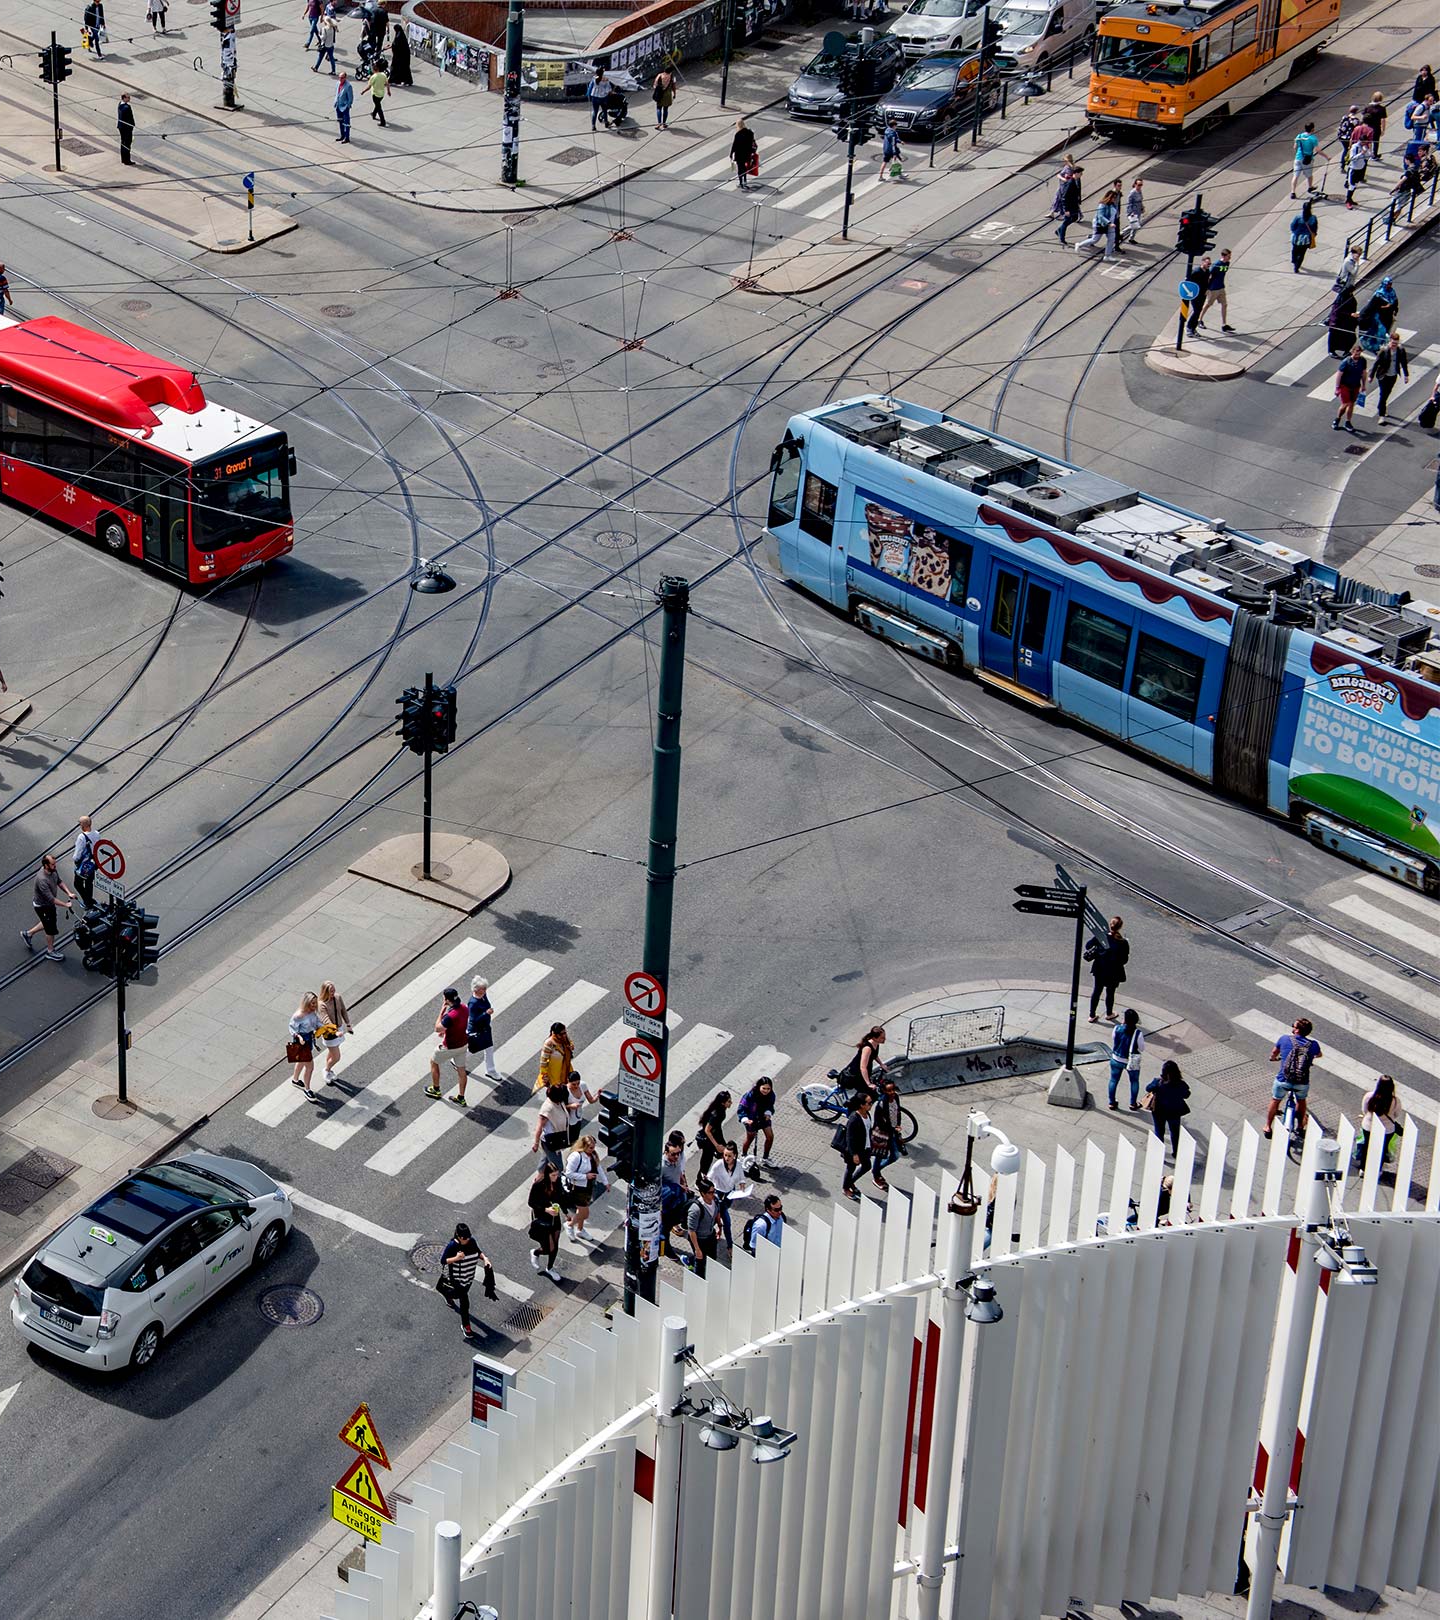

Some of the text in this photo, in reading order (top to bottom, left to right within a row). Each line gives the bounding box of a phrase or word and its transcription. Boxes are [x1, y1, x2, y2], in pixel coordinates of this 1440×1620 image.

[226, 460, 247, 475] Grorud
[1305, 710, 1359, 746] FROM
[1307, 697, 1369, 731] LAYERED
[1370, 723, 1409, 750] WITH
[1303, 726, 1333, 755] TO
[625, 1009, 662, 1029] Gjelder ikke
[625, 1018, 641, 1029] buss
[341, 1498, 382, 1528] Anleggs
[346, 1514, 378, 1539] trafikk
